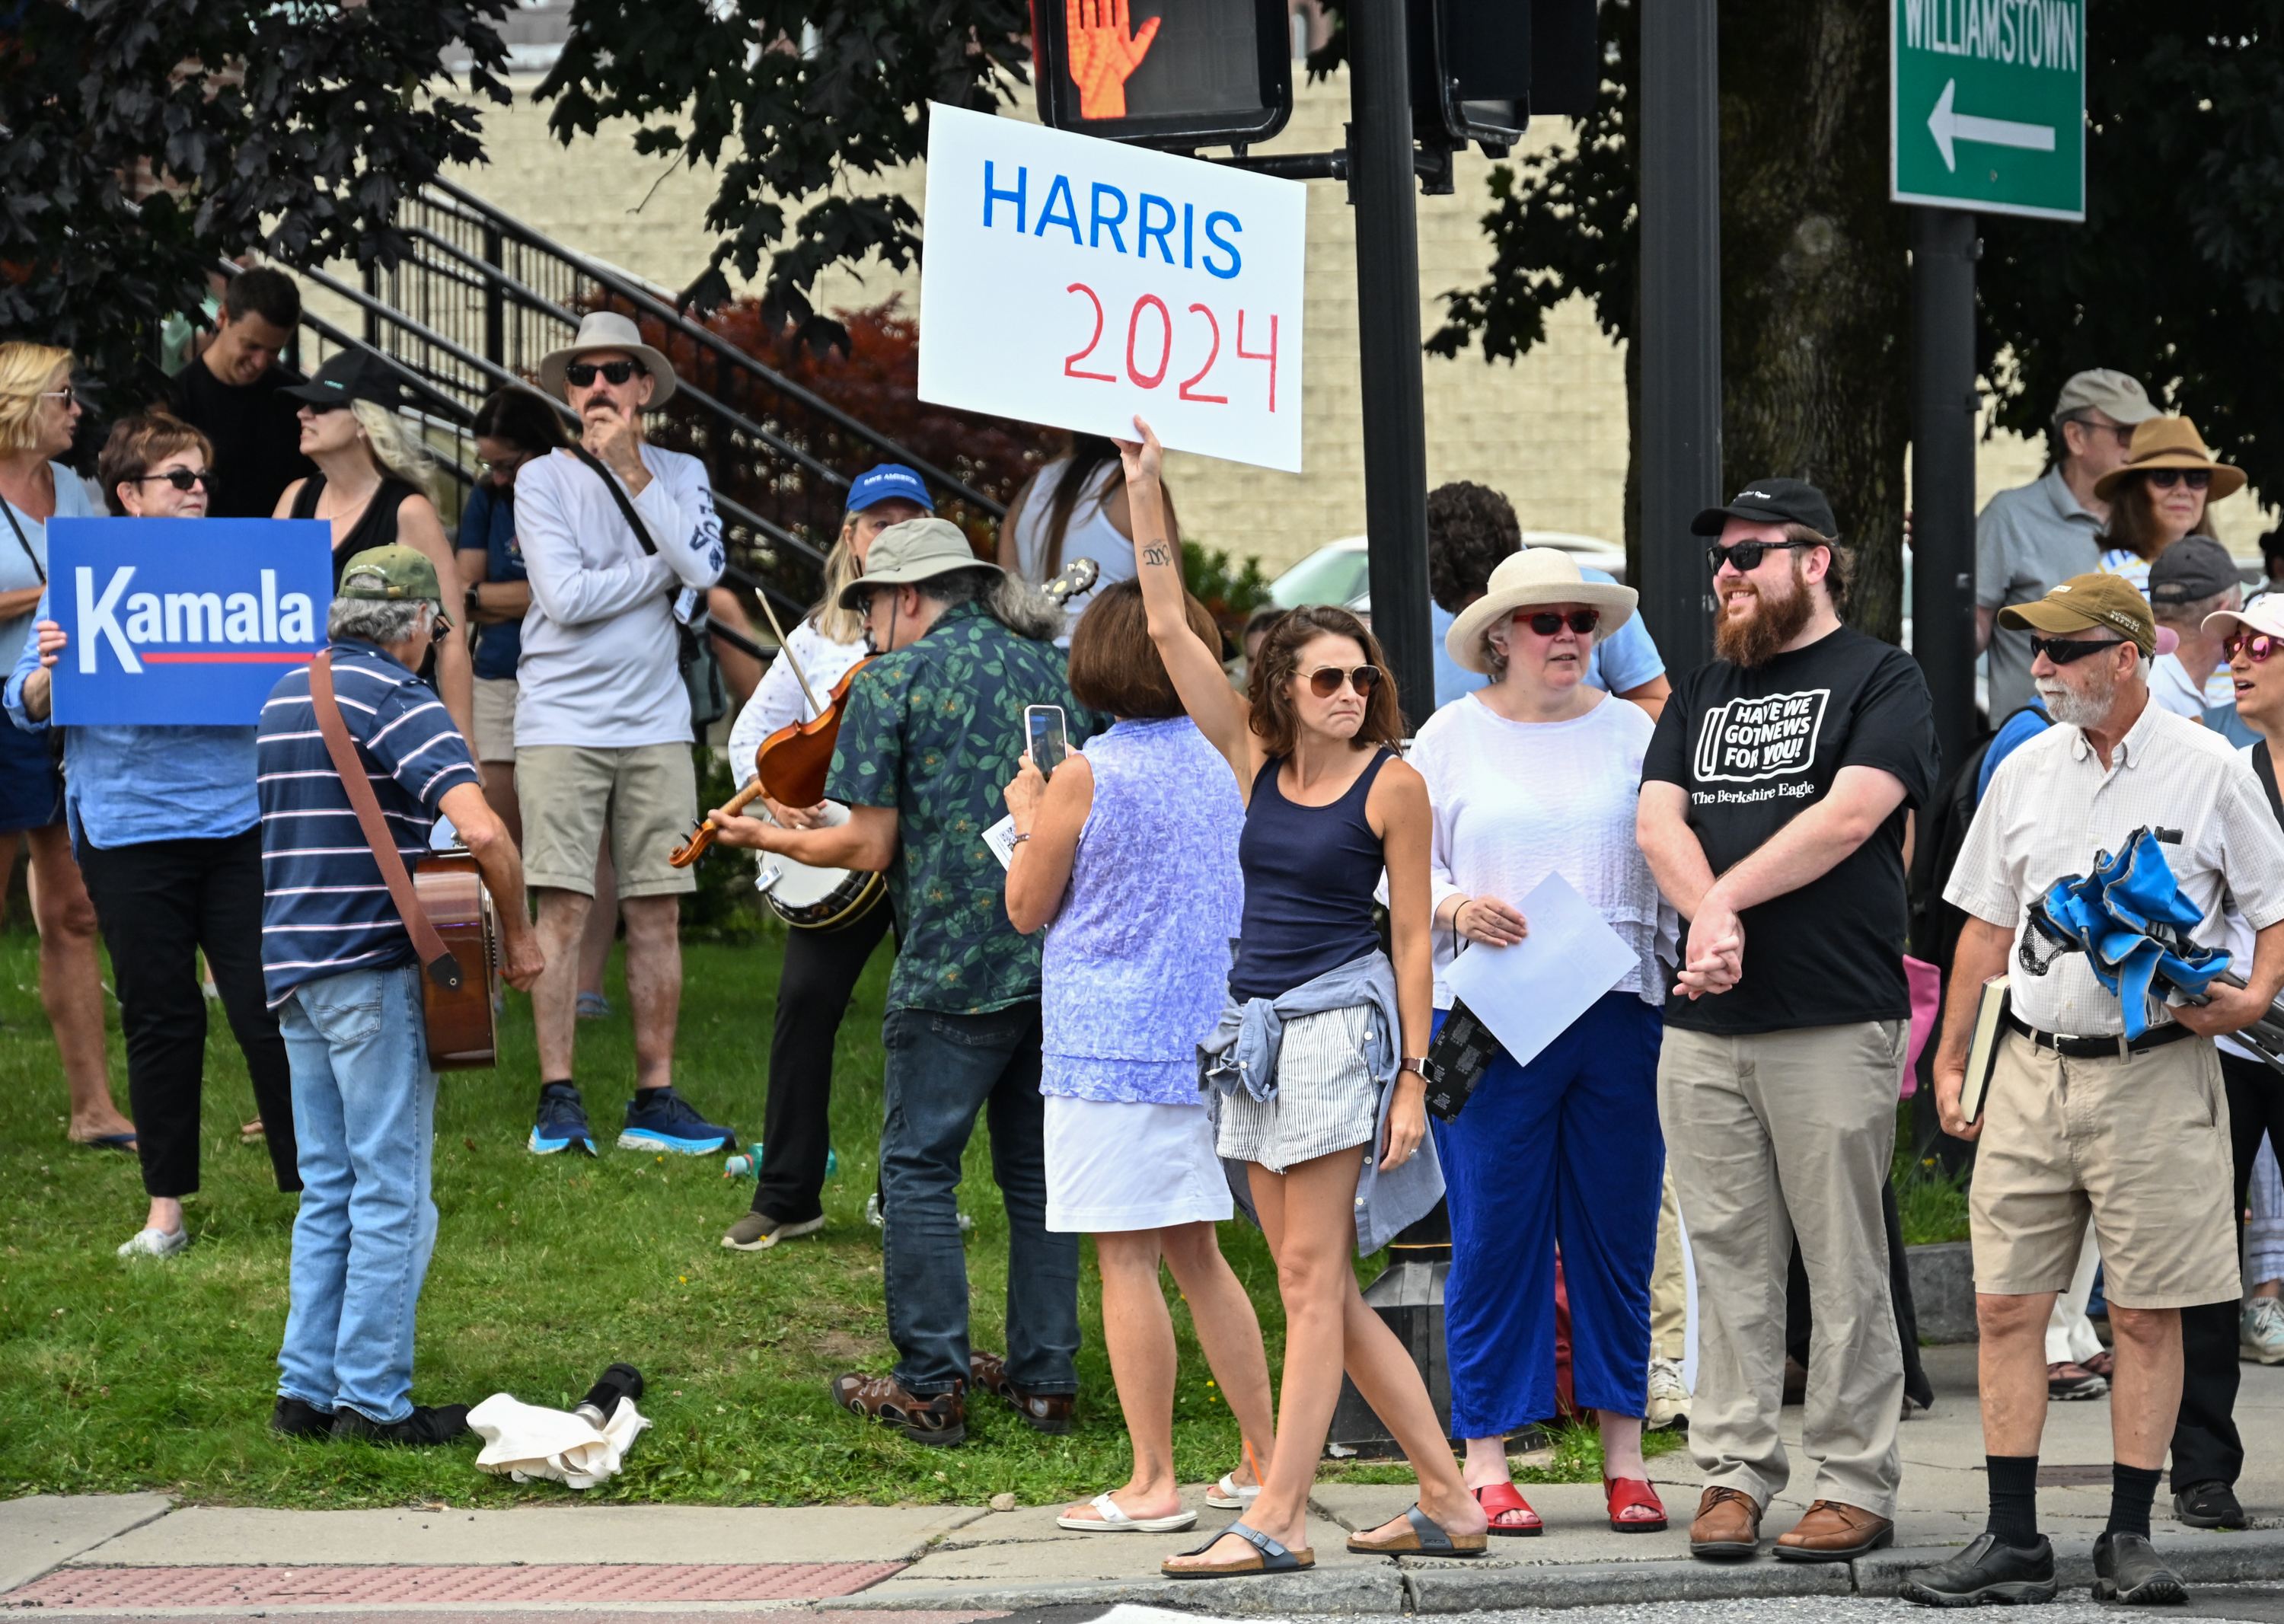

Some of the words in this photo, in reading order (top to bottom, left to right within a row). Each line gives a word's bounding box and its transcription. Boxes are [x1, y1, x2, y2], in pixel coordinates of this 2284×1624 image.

[1905, 0, 2077, 72] WILLIAMSTOWN
[983, 160, 1242, 279] HARRIS
[1064, 282, 1278, 413] 2024
[75, 566, 314, 674] Kamala
[2110, 614, 2139, 633] REFUGE
[2111, 609, 2132, 624] NATIONAL
[1735, 701, 1783, 724] HAVE
[1783, 697, 1813, 716] WE
[1724, 724, 1761, 746] GOT
[1760, 716, 1812, 743] NEWS
[1724, 747, 1759, 768] FOR
[1762, 737, 1804, 765] YOU!
[1692, 791, 1716, 805] The
[1717, 787, 1775, 803] Berkshire
[1778, 781, 1815, 798] Eagle
